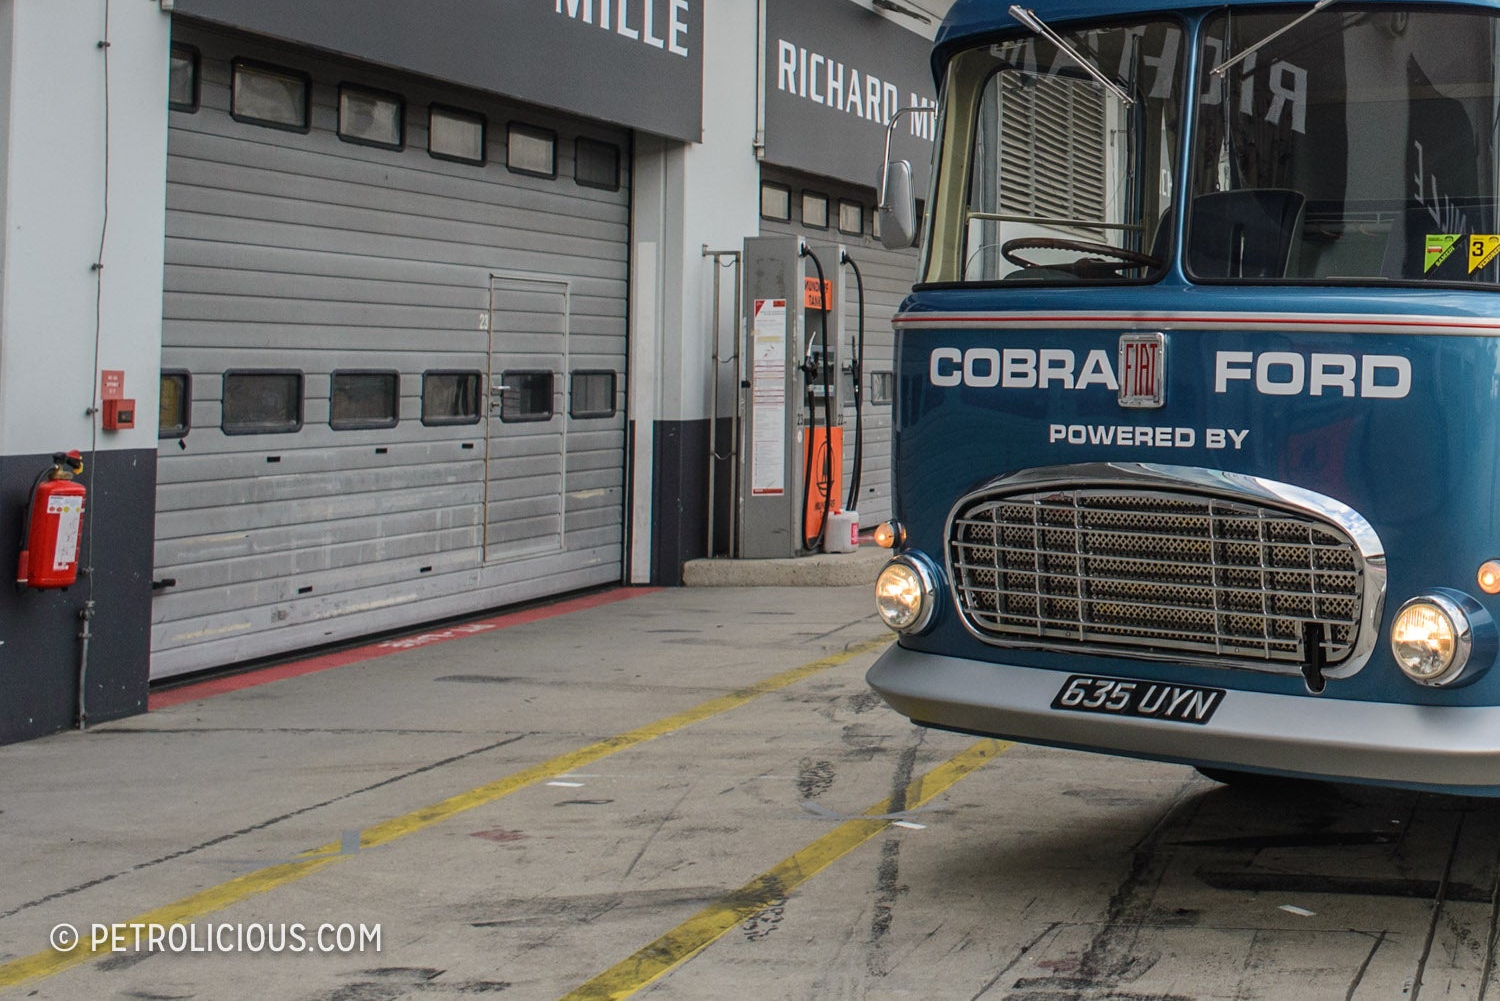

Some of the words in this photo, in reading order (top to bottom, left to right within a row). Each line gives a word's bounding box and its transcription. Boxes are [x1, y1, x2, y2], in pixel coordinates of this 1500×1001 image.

[777, 38, 899, 129] RICHARD
[1472, 241, 1484, 257] 3
[930, 347, 1119, 391] COBRA
[1124, 343, 1158, 397] FIAT
[1214, 351, 1412, 398] FORD
[1049, 424, 1195, 448] POWERED
[1205, 429, 1250, 450] BY
[1061, 678, 1137, 711] 635
[1137, 684, 1217, 720] UYN
